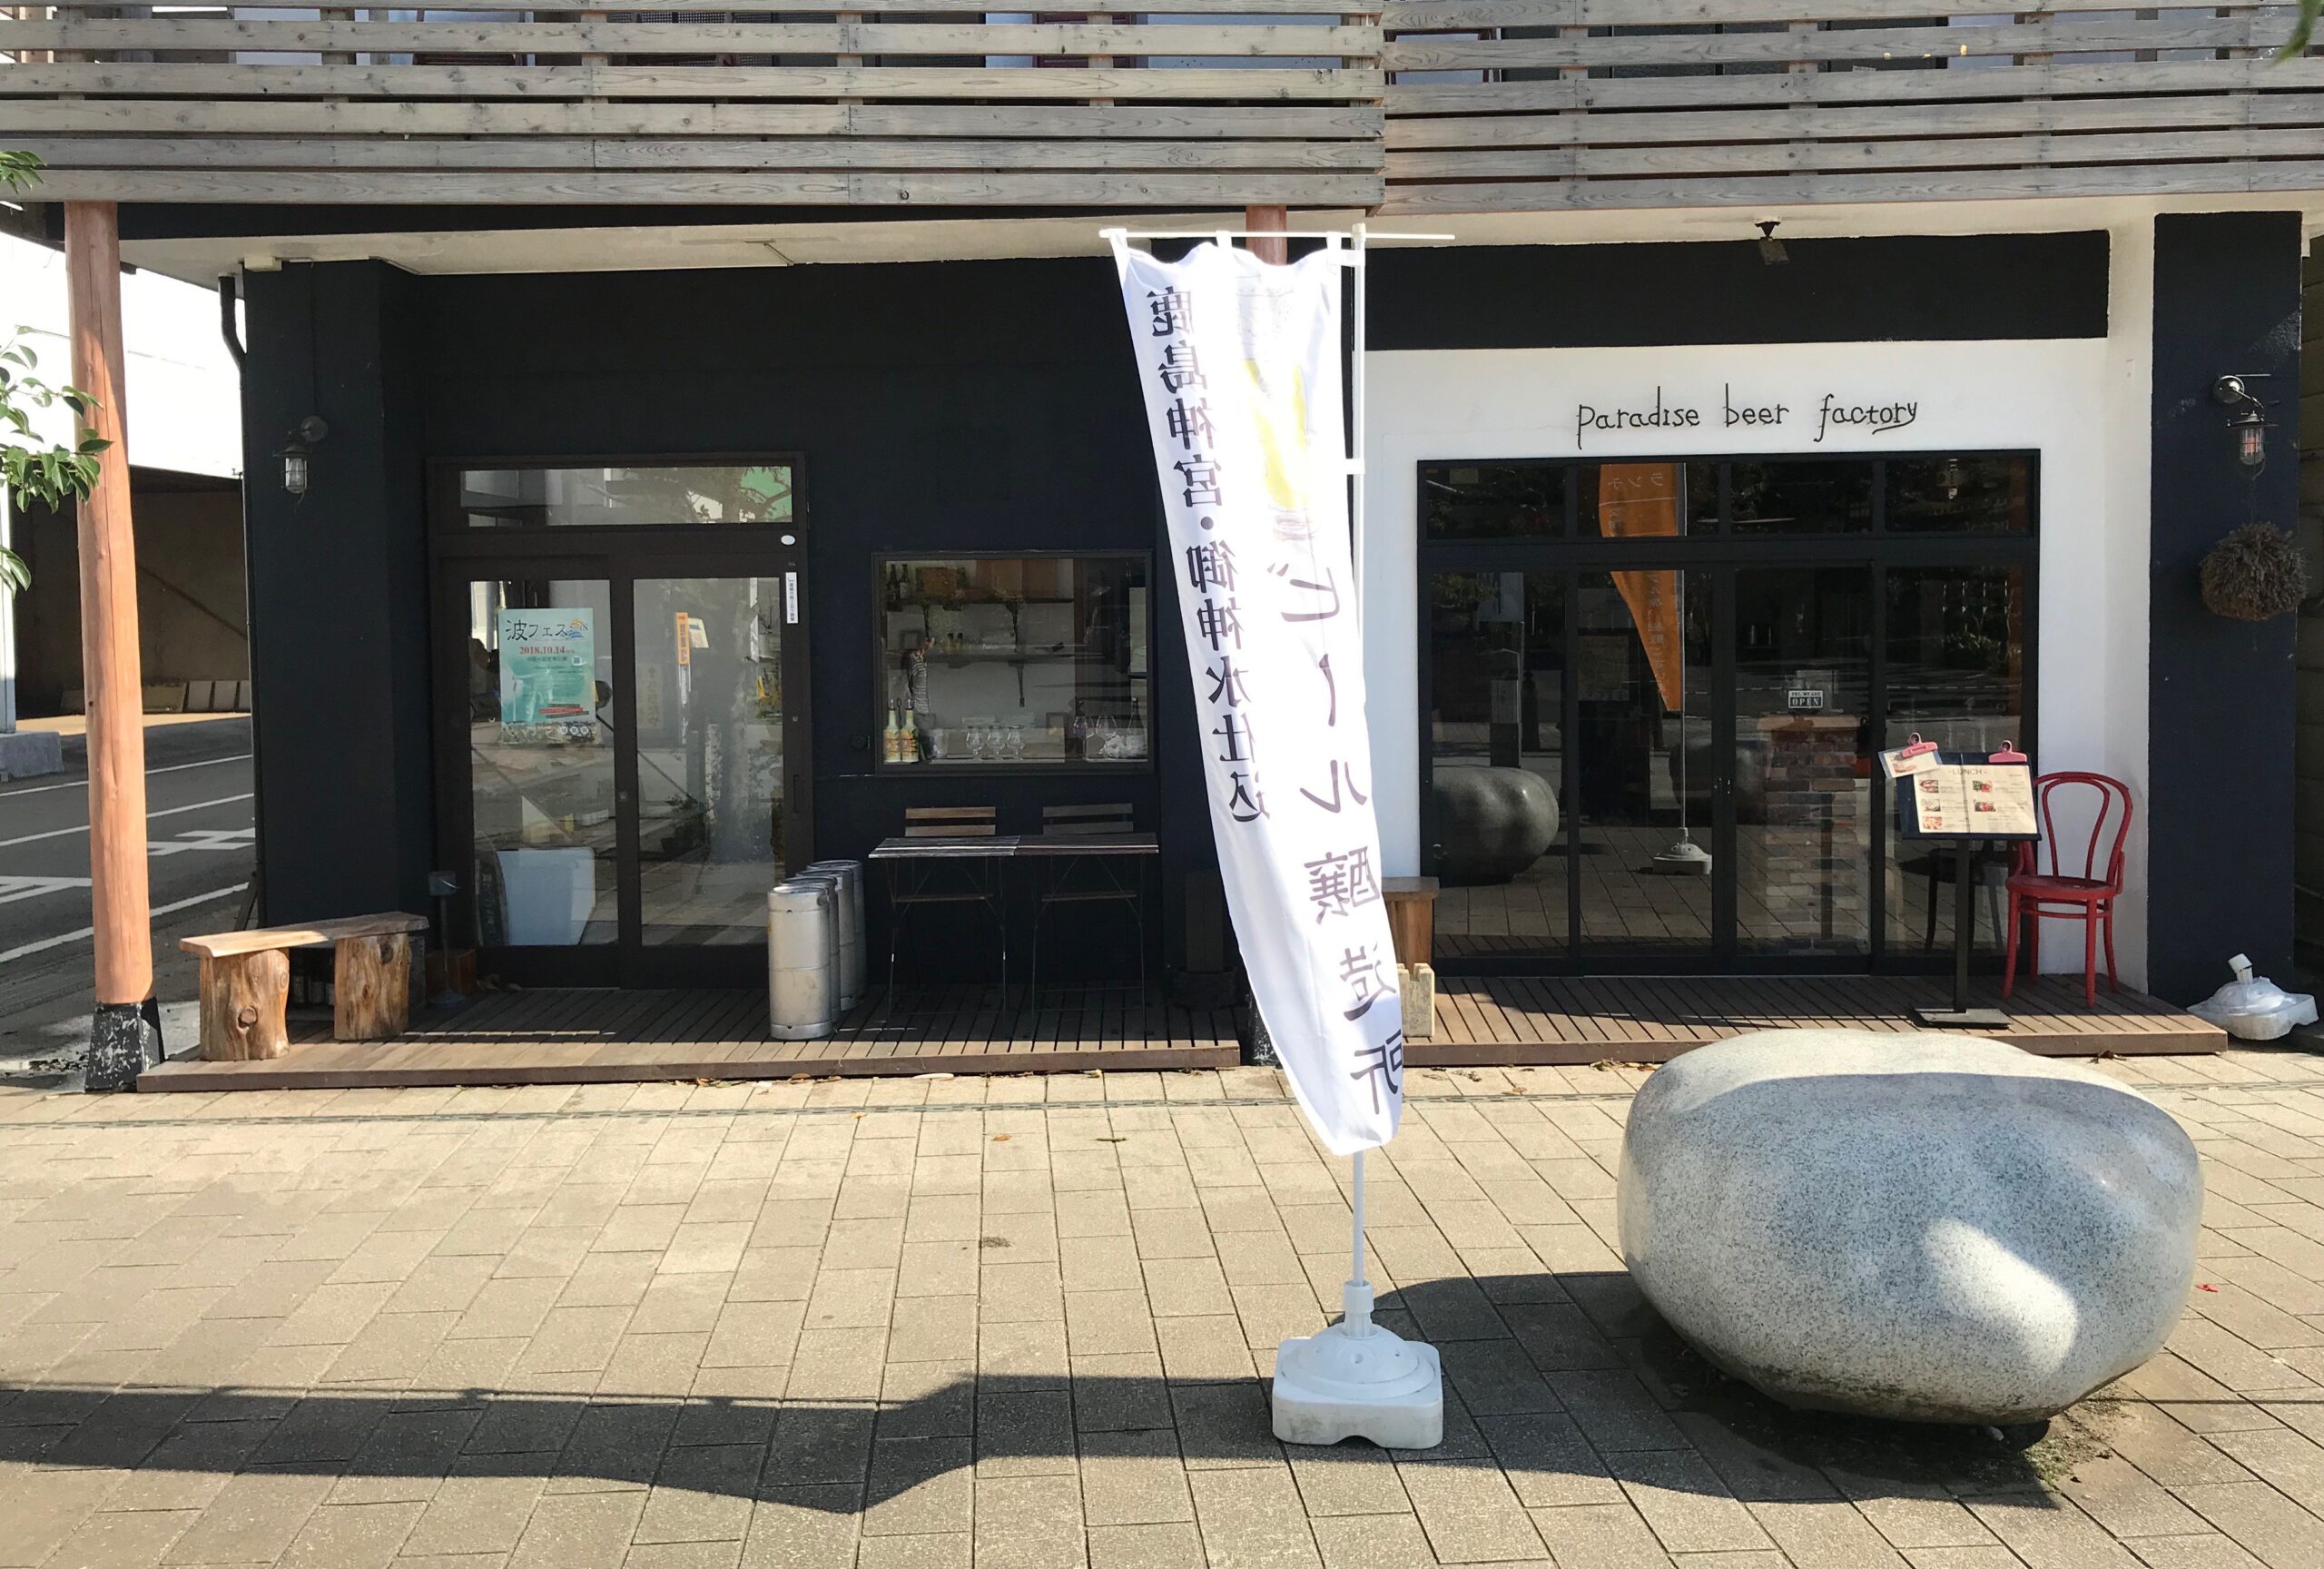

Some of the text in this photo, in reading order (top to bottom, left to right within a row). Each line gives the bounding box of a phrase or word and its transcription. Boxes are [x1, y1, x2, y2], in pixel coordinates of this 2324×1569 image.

[1576, 383, 1918, 450] paradise beer factory
[505, 619, 569, 641] 波フェス
[519, 646, 566, 655] 2018.10.14
[1792, 697, 1819, 706] OPEN
